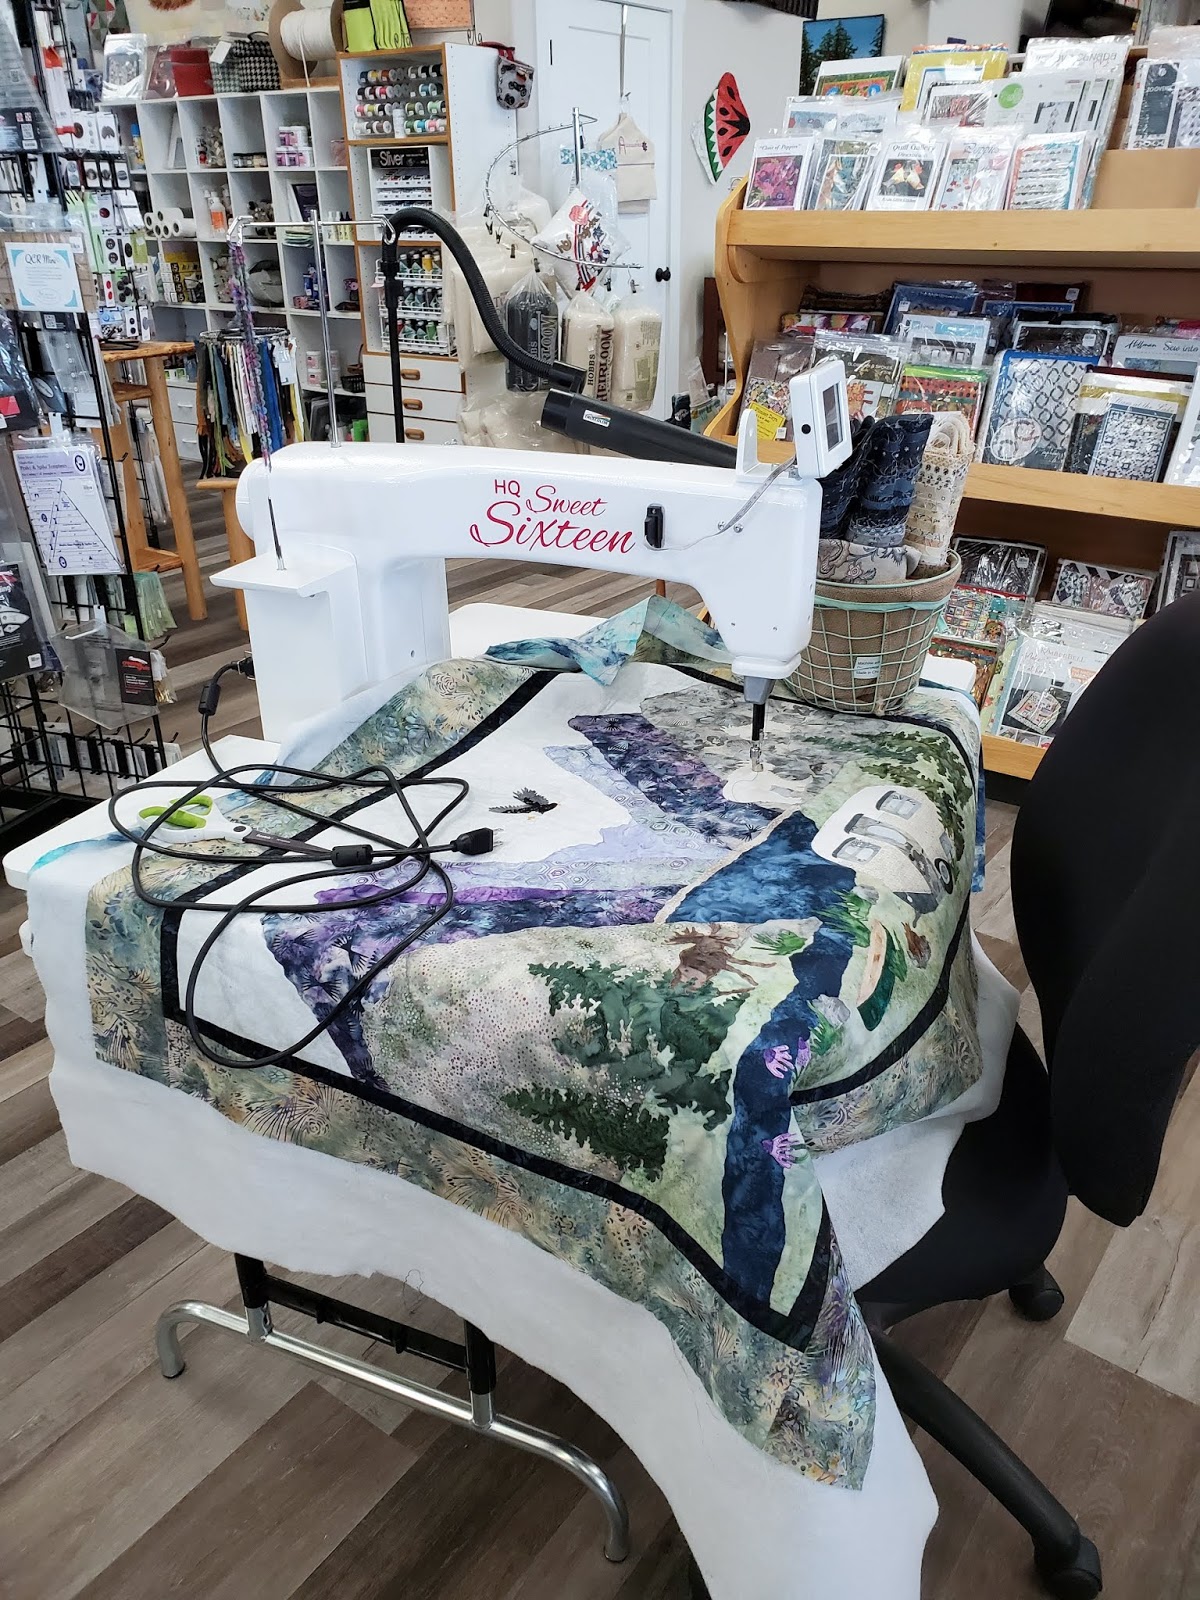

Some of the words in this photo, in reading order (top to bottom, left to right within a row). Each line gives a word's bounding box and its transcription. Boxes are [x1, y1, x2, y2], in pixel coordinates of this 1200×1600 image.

[25, 253, 42, 265] QCR
[596, 327, 615, 402] HEIRLOOM
[1163, 341, 1181, 352] Sew
[587, 353, 597, 387] HOBBS
[494, 479, 521, 498] HQ
[525, 485, 609, 517] Sweet
[469, 500, 636, 554] Sixteen
